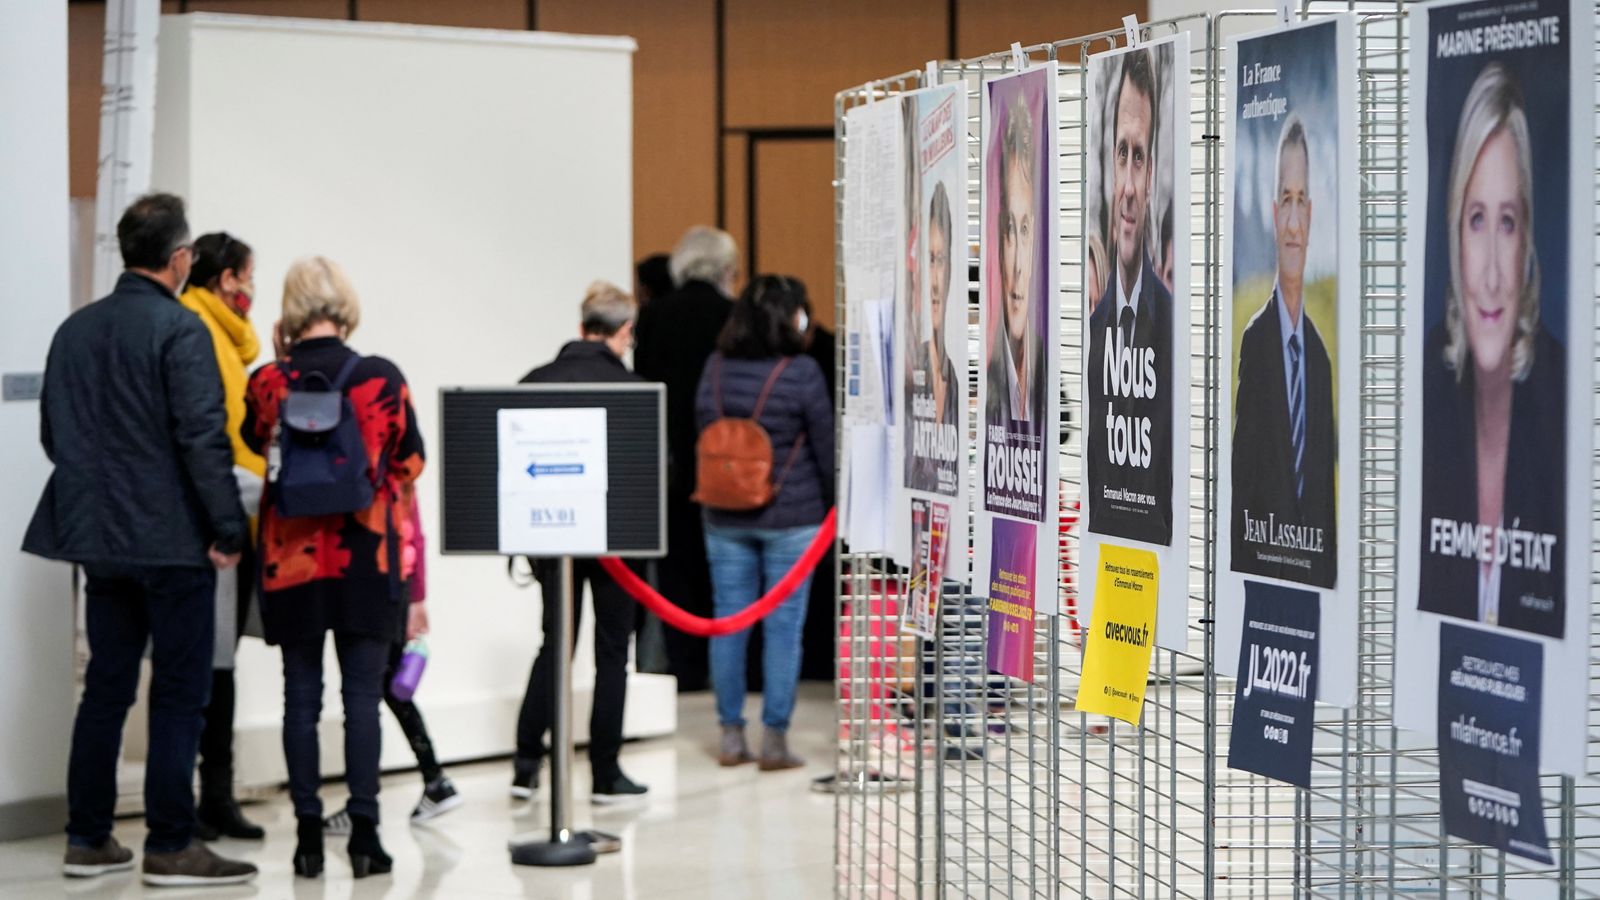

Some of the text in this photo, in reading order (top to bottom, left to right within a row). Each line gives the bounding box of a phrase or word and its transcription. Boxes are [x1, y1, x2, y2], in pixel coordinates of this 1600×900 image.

[1436, 15, 1560, 59] MARINE PRÉSIDENTE
[1243, 62, 1282, 87] La France
[1242, 92, 1287, 121] authentique
[1103, 326, 1157, 400] Nous
[912, 420, 958, 463] ARTHAUD
[1106, 402, 1152, 469] tous
[987, 443, 1042, 497] ROUSSEL
[1430, 516, 1557, 573] FEMME D'ÉTAT
[1105, 619, 1149, 648] avecvous.fr
[1243, 643, 1311, 699] JL2022.fr
[1450, 713, 1523, 758] mlafrance.fr
